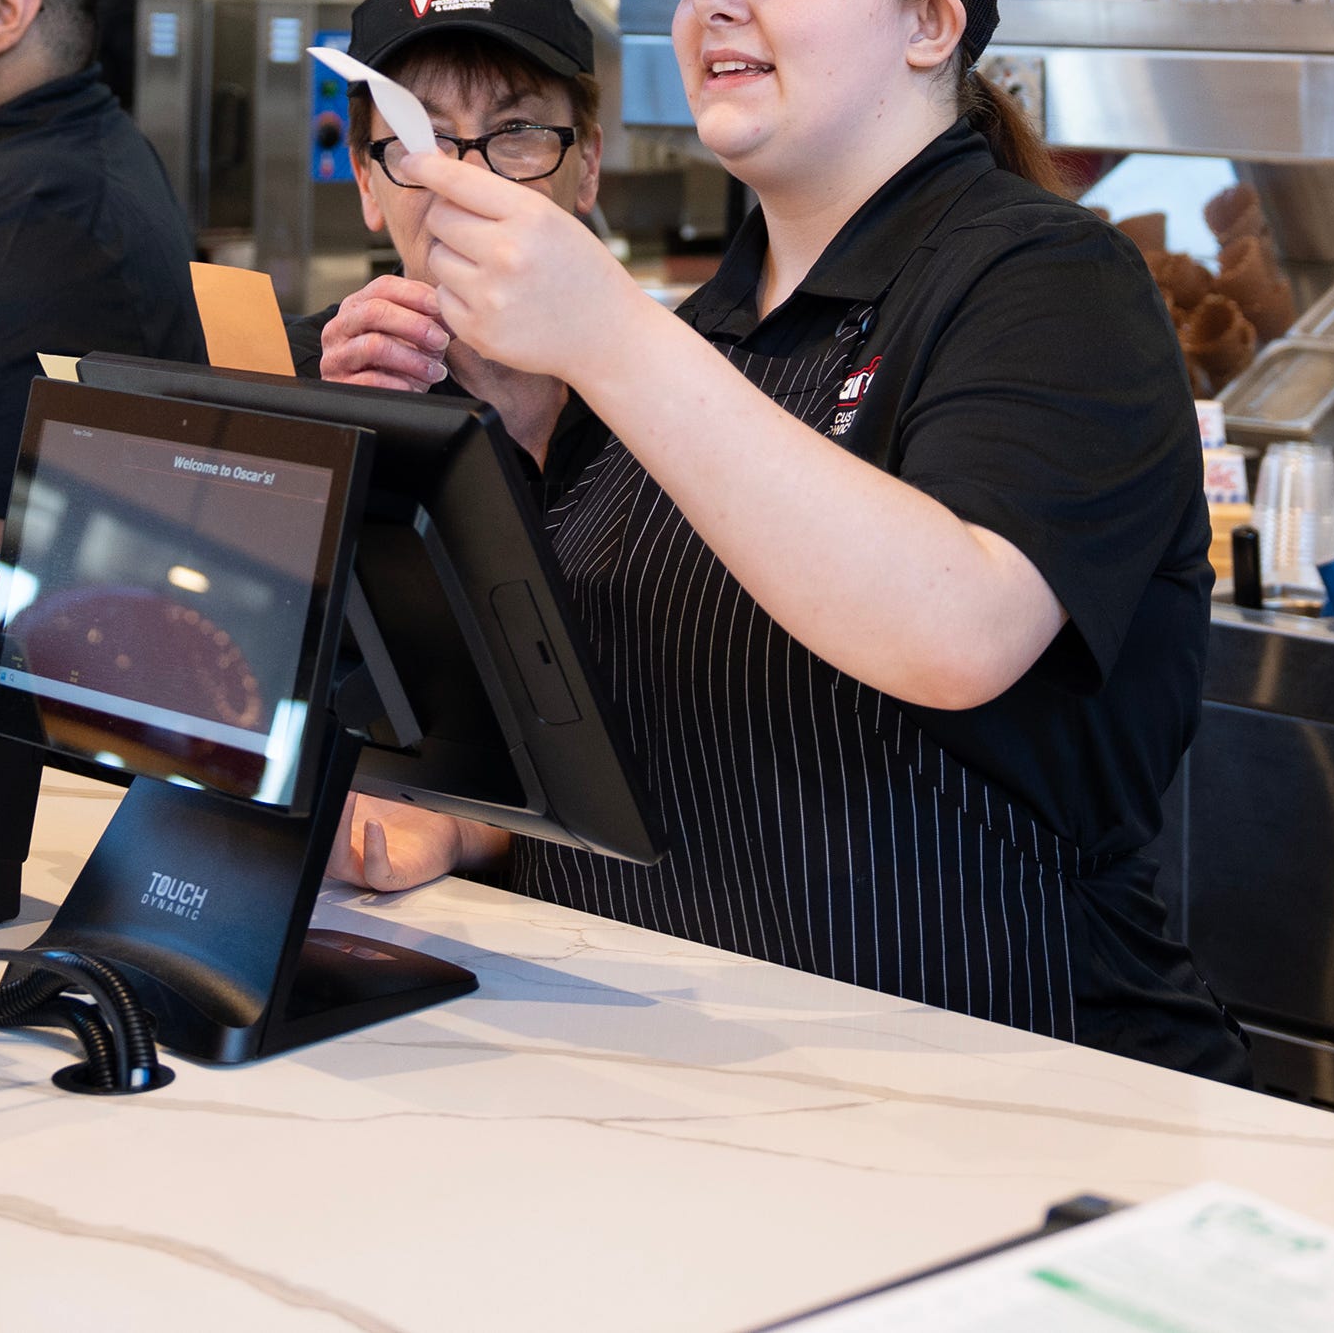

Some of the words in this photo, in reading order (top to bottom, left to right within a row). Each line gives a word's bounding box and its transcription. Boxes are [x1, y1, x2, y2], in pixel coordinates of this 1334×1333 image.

[173, 454, 219, 476] Welcome
[219, 464, 232, 478] to
[233, 465, 277, 486] Oscar's!
[148, 871, 210, 909] TOUCH
[141, 893, 201, 921] DYNAMIC
